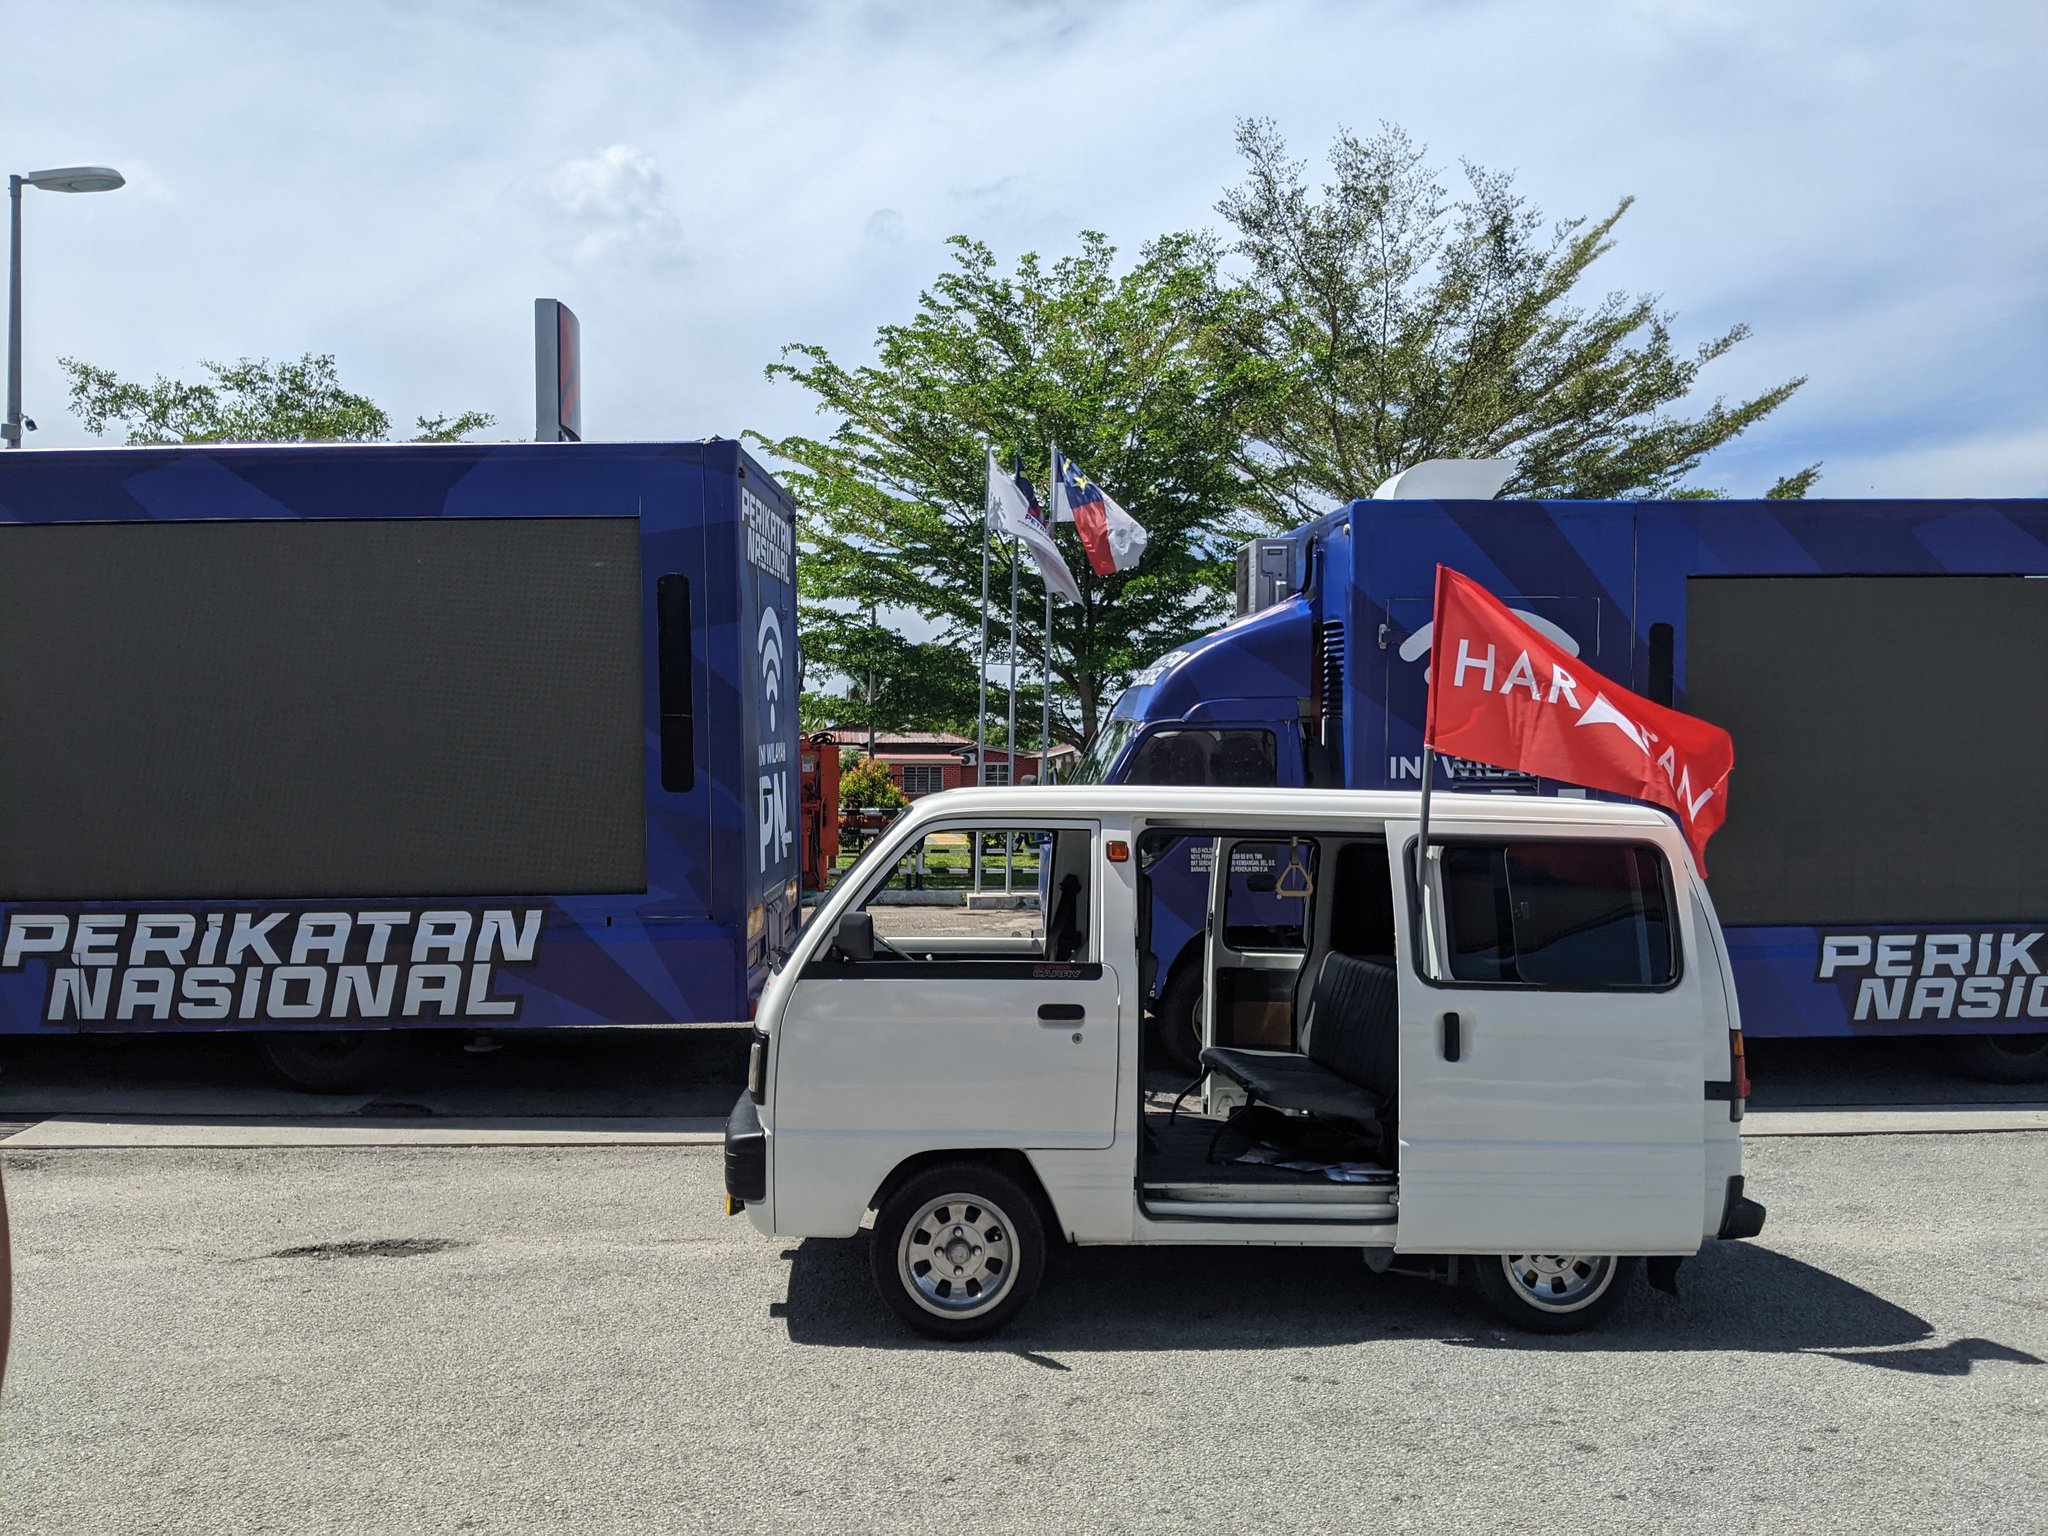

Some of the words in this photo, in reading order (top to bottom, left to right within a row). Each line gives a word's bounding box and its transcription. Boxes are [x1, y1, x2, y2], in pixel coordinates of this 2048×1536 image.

[741, 486, 792, 556] PERIKATAN
[747, 526, 790, 585] NASIONAL
[759, 770, 788, 874] PN
[2, 909, 543, 967] PERIKATAN
[1819, 933, 2048, 978] PERIK
[46, 963, 517, 1021] NASIONAL
[1032, 970, 1081, 978] CARRY
